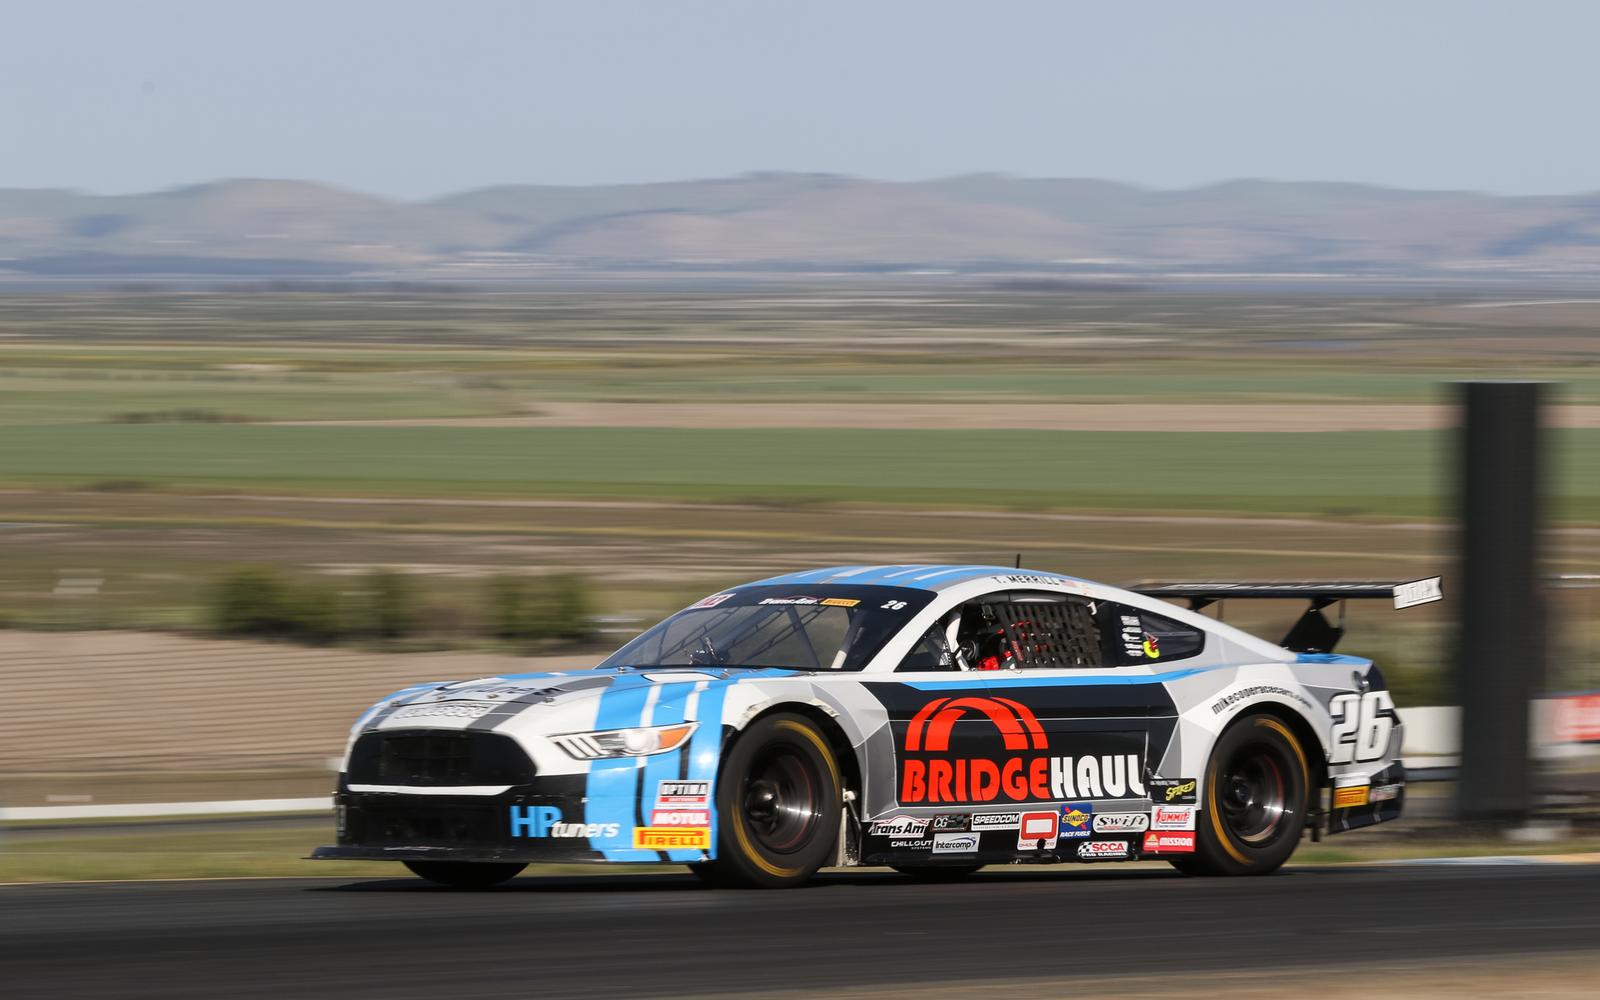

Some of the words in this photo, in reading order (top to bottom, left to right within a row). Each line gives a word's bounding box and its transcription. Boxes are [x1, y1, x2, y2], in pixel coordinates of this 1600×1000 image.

[1006, 575, 1060, 586] MERRILL
[880, 600, 908, 610] 26
[1328, 688, 1395, 766] 26
[509, 805, 563, 838] HP
[652, 812, 709, 825] MOTUL
[934, 817, 949, 828] CG
[973, 814, 1019, 825] SPEEDCOM
[1062, 814, 1090, 823] SUNOCO
[1096, 815, 1146, 827] Swift
[551, 821, 620, 838] tuners
[871, 821, 902, 834] Trans
[903, 821, 925, 834] Am
[639, 830, 705, 846] PIRELLI
[891, 840, 933, 848] CHILLOUT
[935, 838, 972, 851] Intercomp
[1092, 843, 1125, 852] SCCA
